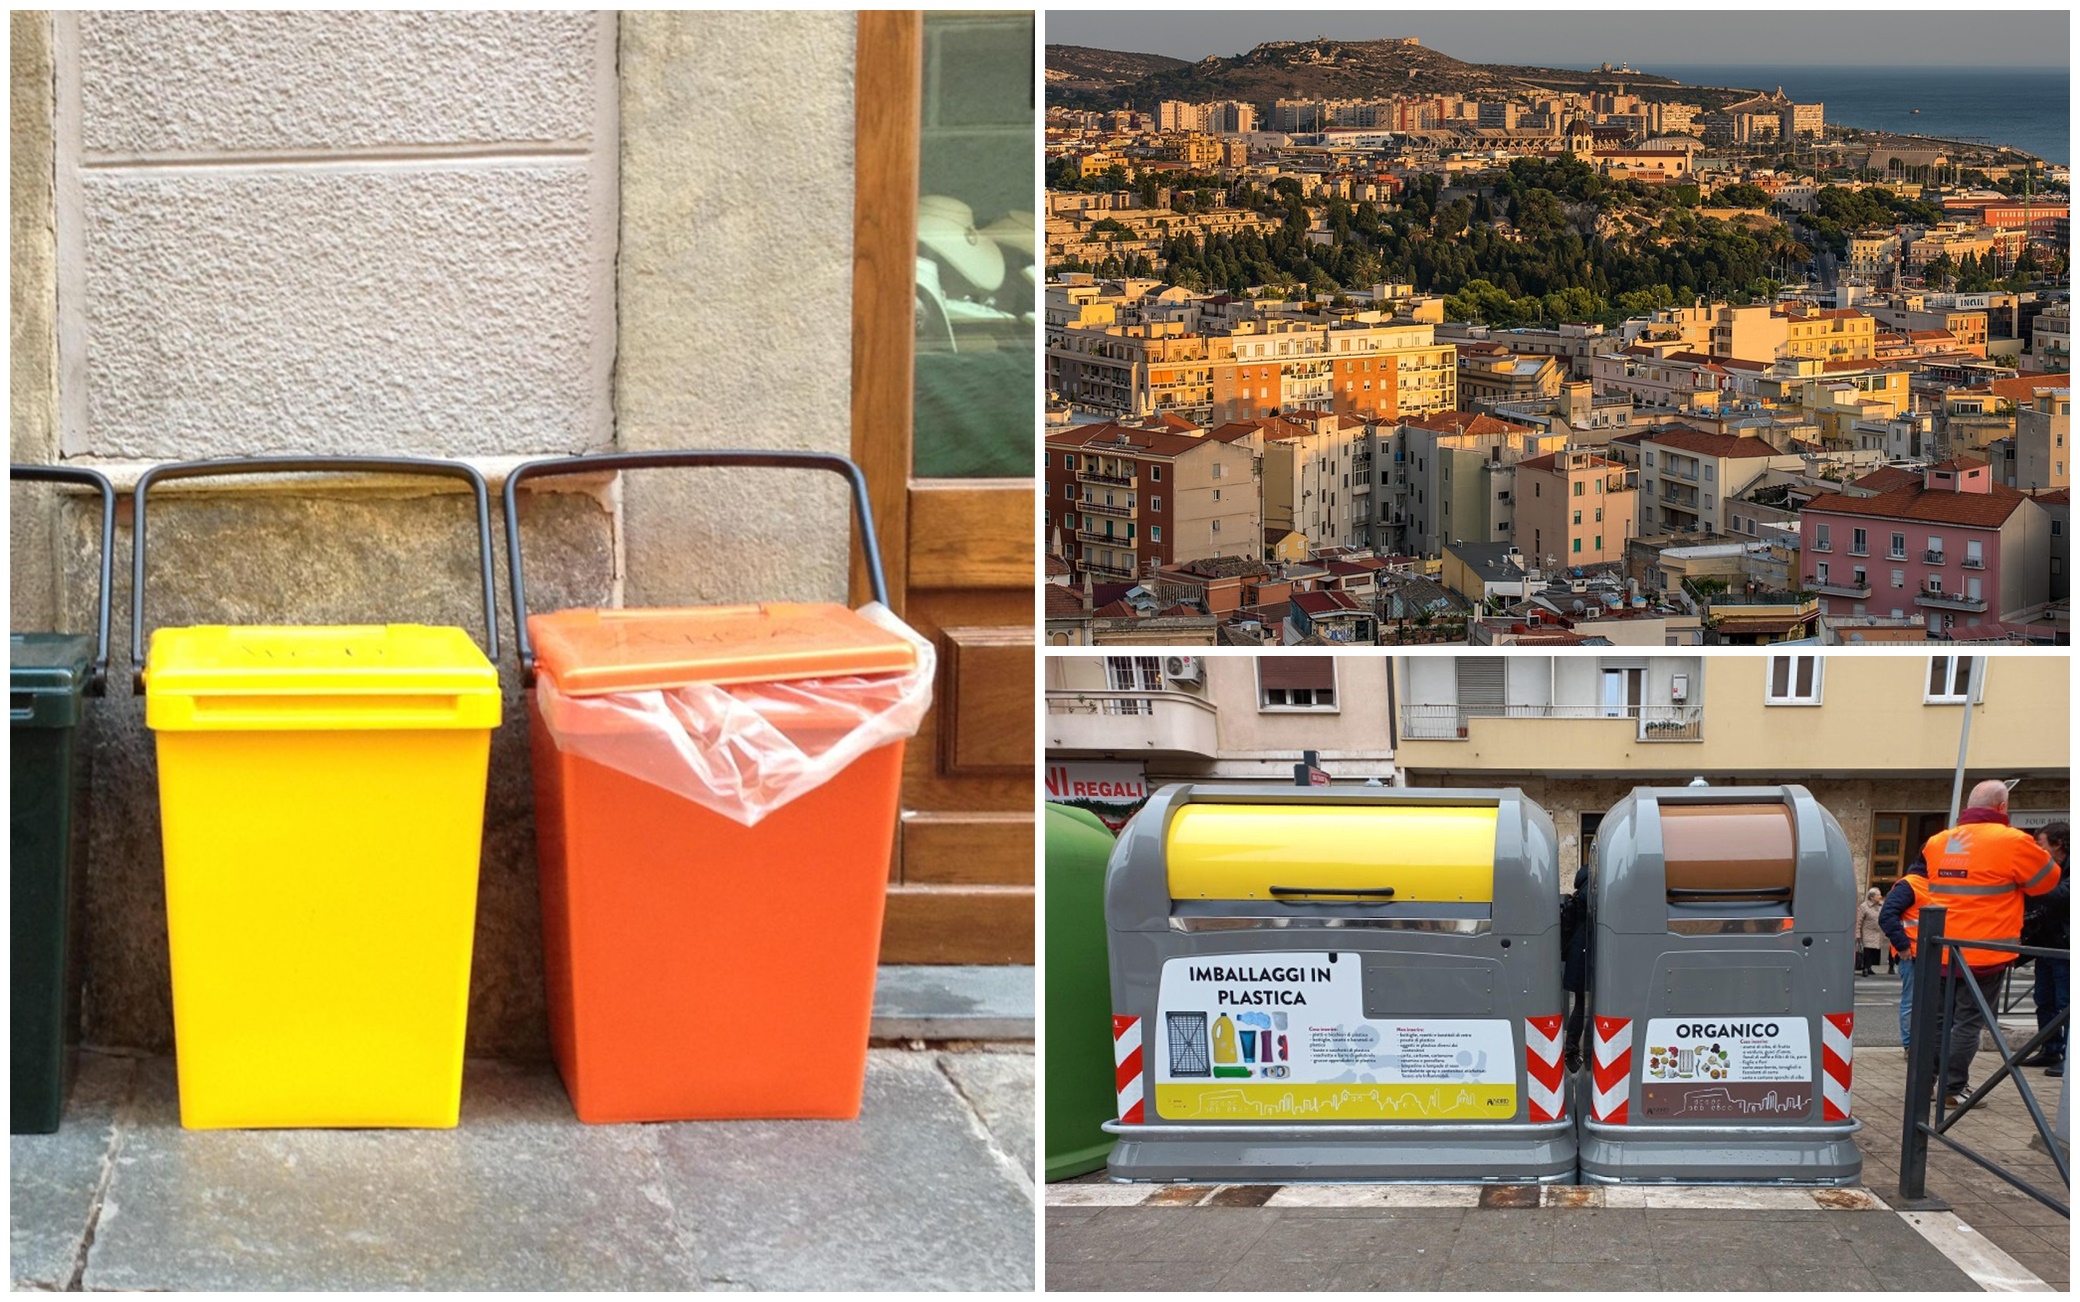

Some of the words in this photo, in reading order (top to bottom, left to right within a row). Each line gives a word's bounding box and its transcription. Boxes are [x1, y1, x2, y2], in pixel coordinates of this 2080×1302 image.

[1073, 781, 1143, 797] REGALI
[1189, 966, 1305, 982] IMBALLAGGI
[1311, 967, 1331, 982] IN
[1218, 990, 1307, 1005] PLASTICA
[1676, 1023, 1780, 1039] ORGANICO
